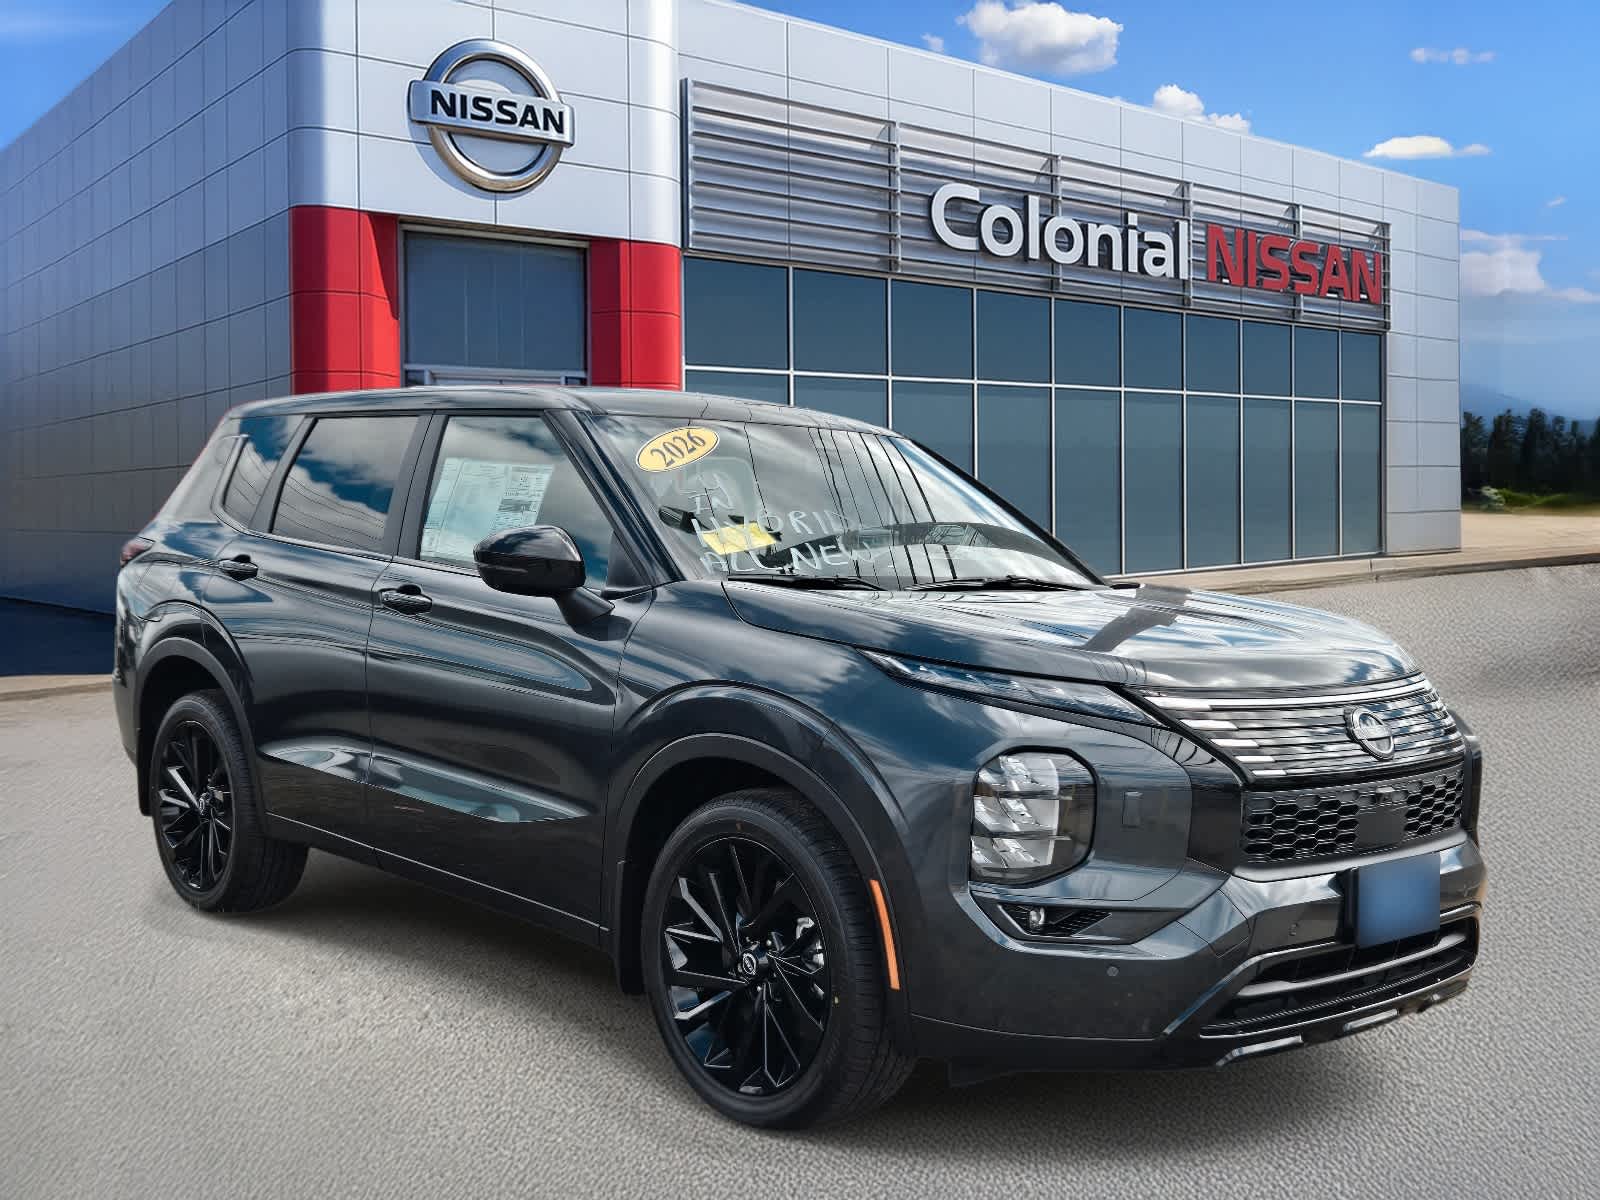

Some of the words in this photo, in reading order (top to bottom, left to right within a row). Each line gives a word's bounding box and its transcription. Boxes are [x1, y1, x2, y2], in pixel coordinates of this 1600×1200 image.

[430, 89, 564, 134] NISSAN
[930, 182, 1189, 280] Colonial
[1206, 223, 1383, 305] NISSAN
[650, 430, 706, 467] 2026
